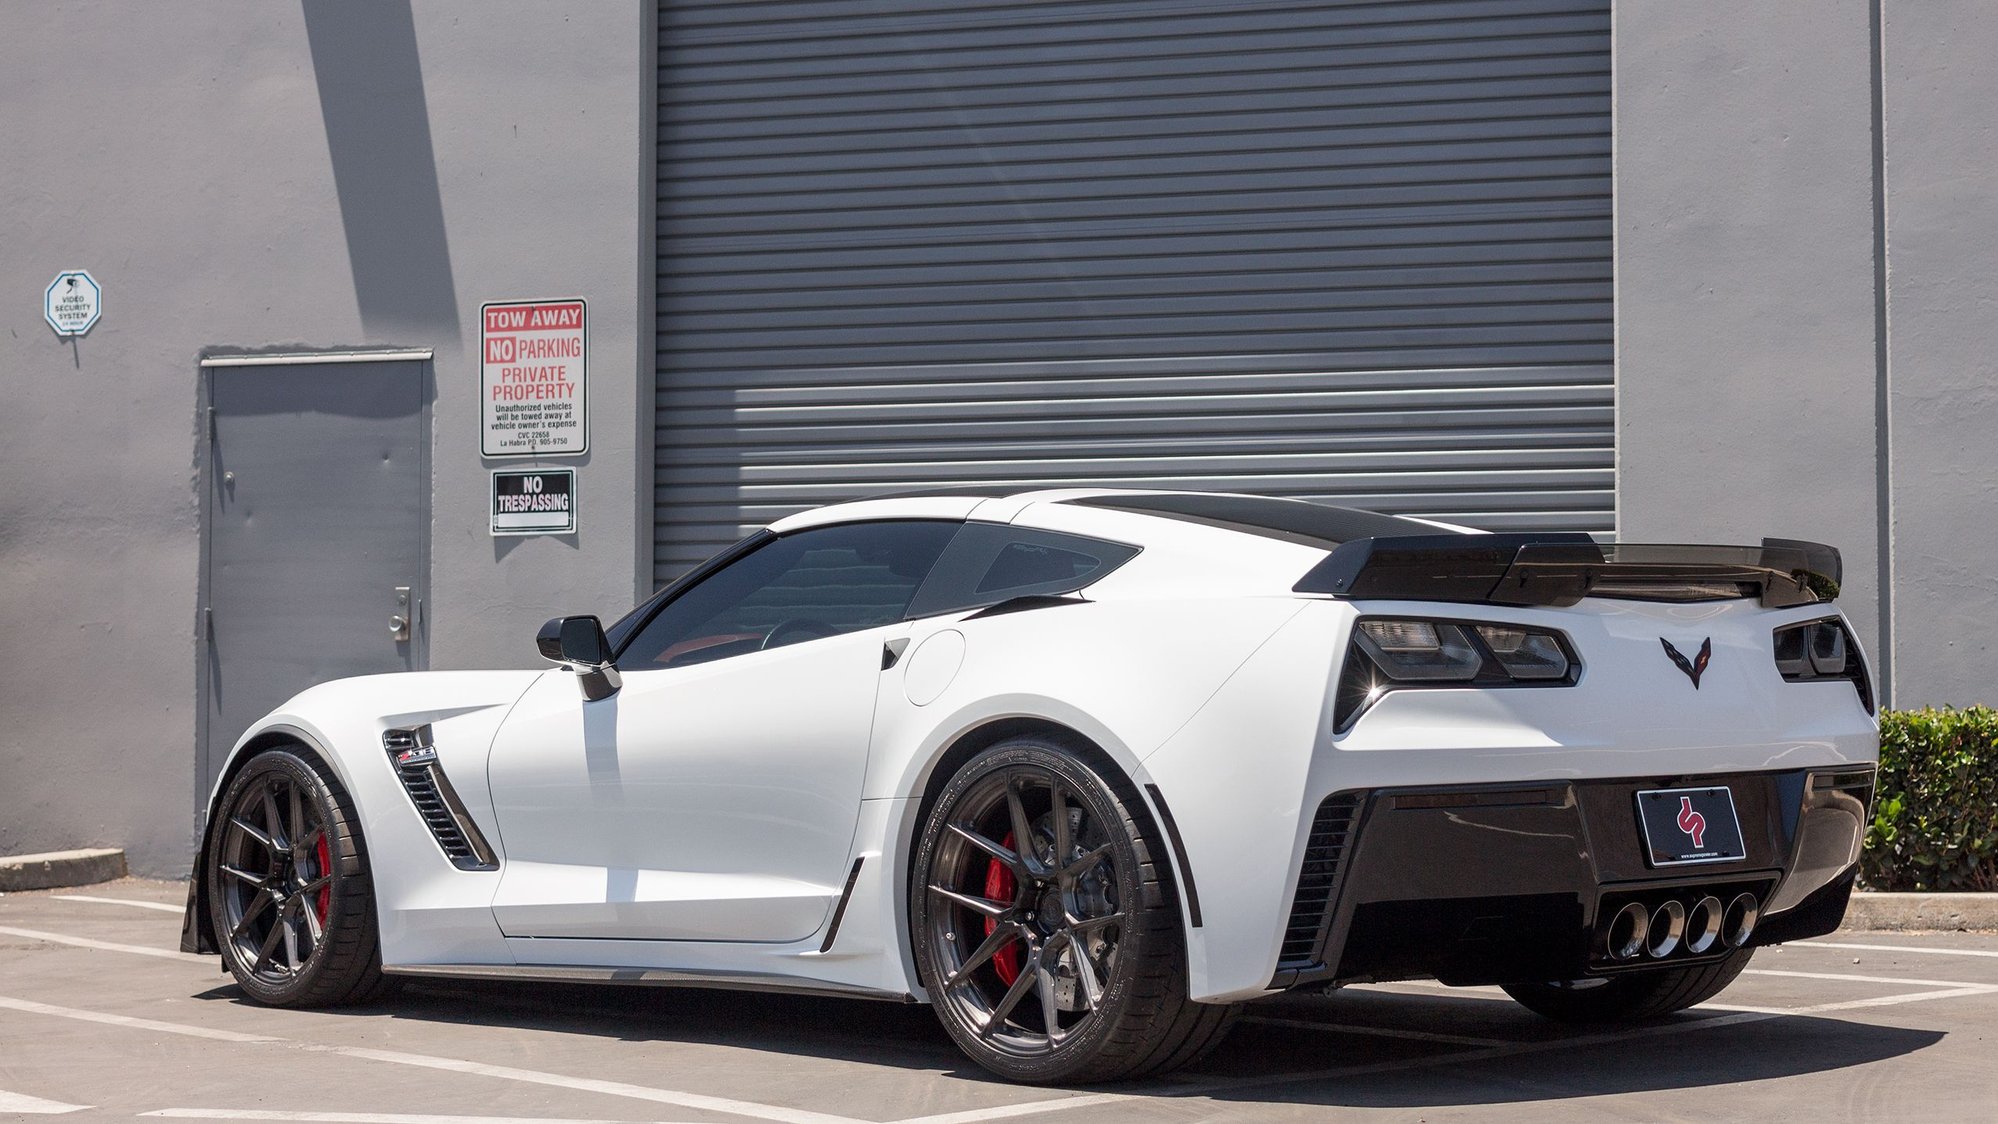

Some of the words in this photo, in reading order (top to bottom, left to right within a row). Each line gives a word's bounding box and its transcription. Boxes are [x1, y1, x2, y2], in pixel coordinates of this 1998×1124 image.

[488, 310, 526, 328] TOW
[530, 308, 580, 327] AWAY
[489, 339, 514, 361] NO
[519, 337, 581, 360] PARKING
[502, 366, 566, 383] PRIVATE
[493, 383, 575, 400] PROPERTY
[495, 403, 542, 413] Unauthorized
[543, 402, 573, 411] vehicles
[496, 413, 509, 421] will
[510, 413, 520, 421] be
[521, 412, 542, 420] towed
[544, 412, 563, 420] away
[564, 411, 572, 419] at
[491, 421, 516, 430] vehicle
[518, 420, 546, 429] owner's
[547, 420, 577, 429] expense
[518, 431, 530, 439] CVC
[523, 476, 543, 493] NO
[498, 493, 569, 512] TRESPASSING
